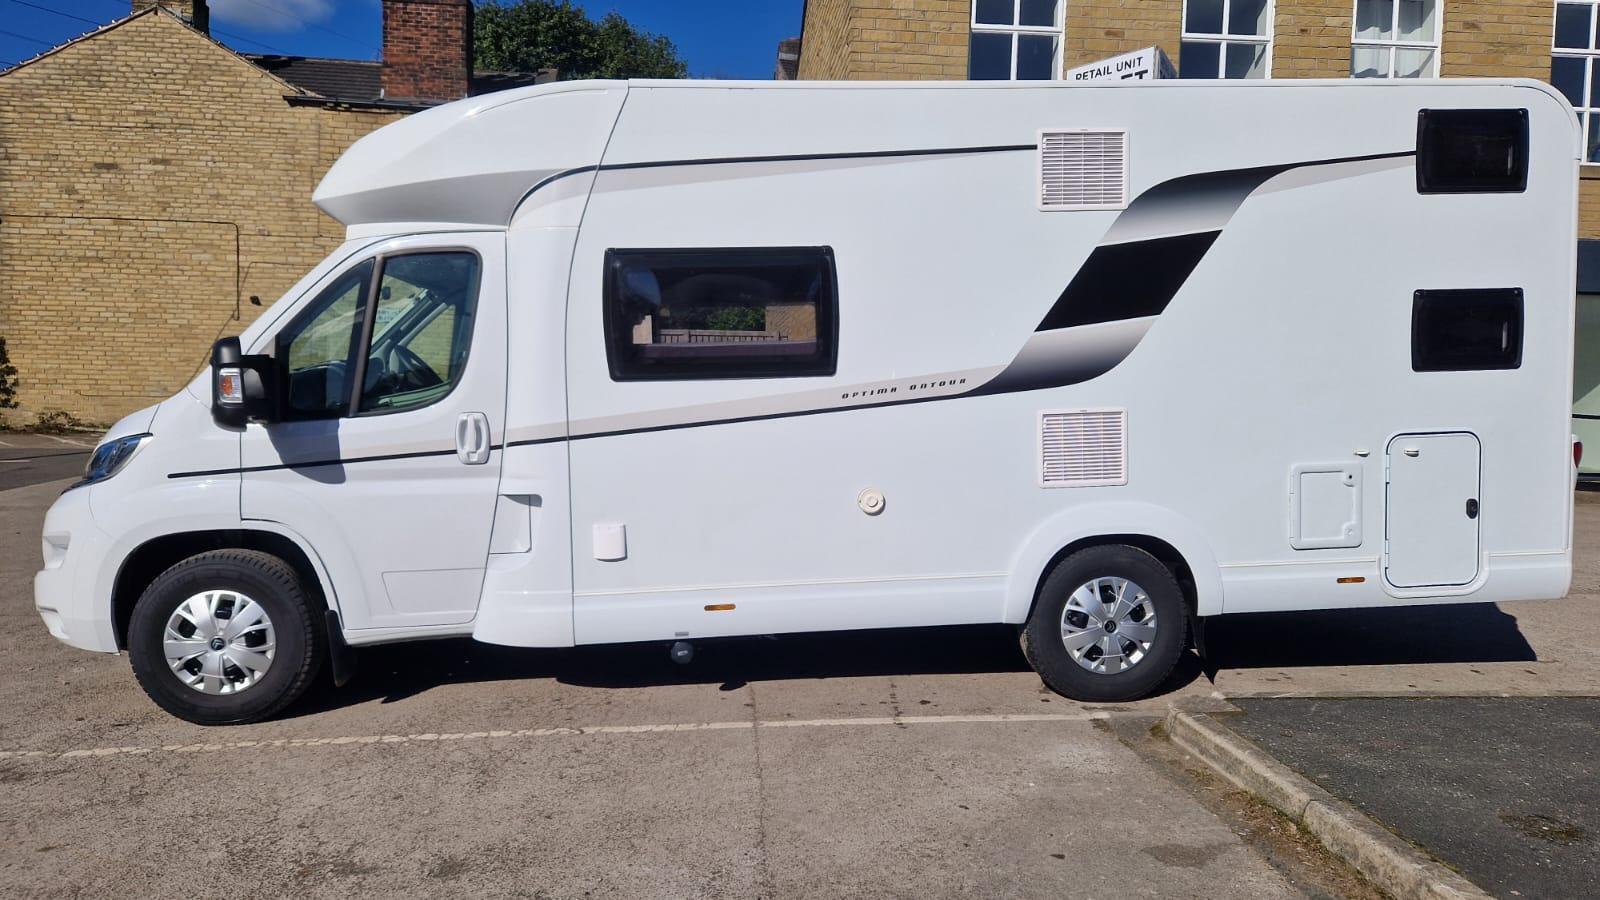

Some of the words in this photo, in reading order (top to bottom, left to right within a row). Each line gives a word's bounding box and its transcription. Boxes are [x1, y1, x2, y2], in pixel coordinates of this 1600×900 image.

[1075, 65, 1112, 80] RETAIL
[1116, 57, 1143, 72] UNIT
[842, 387, 897, 399] OPTIMA
